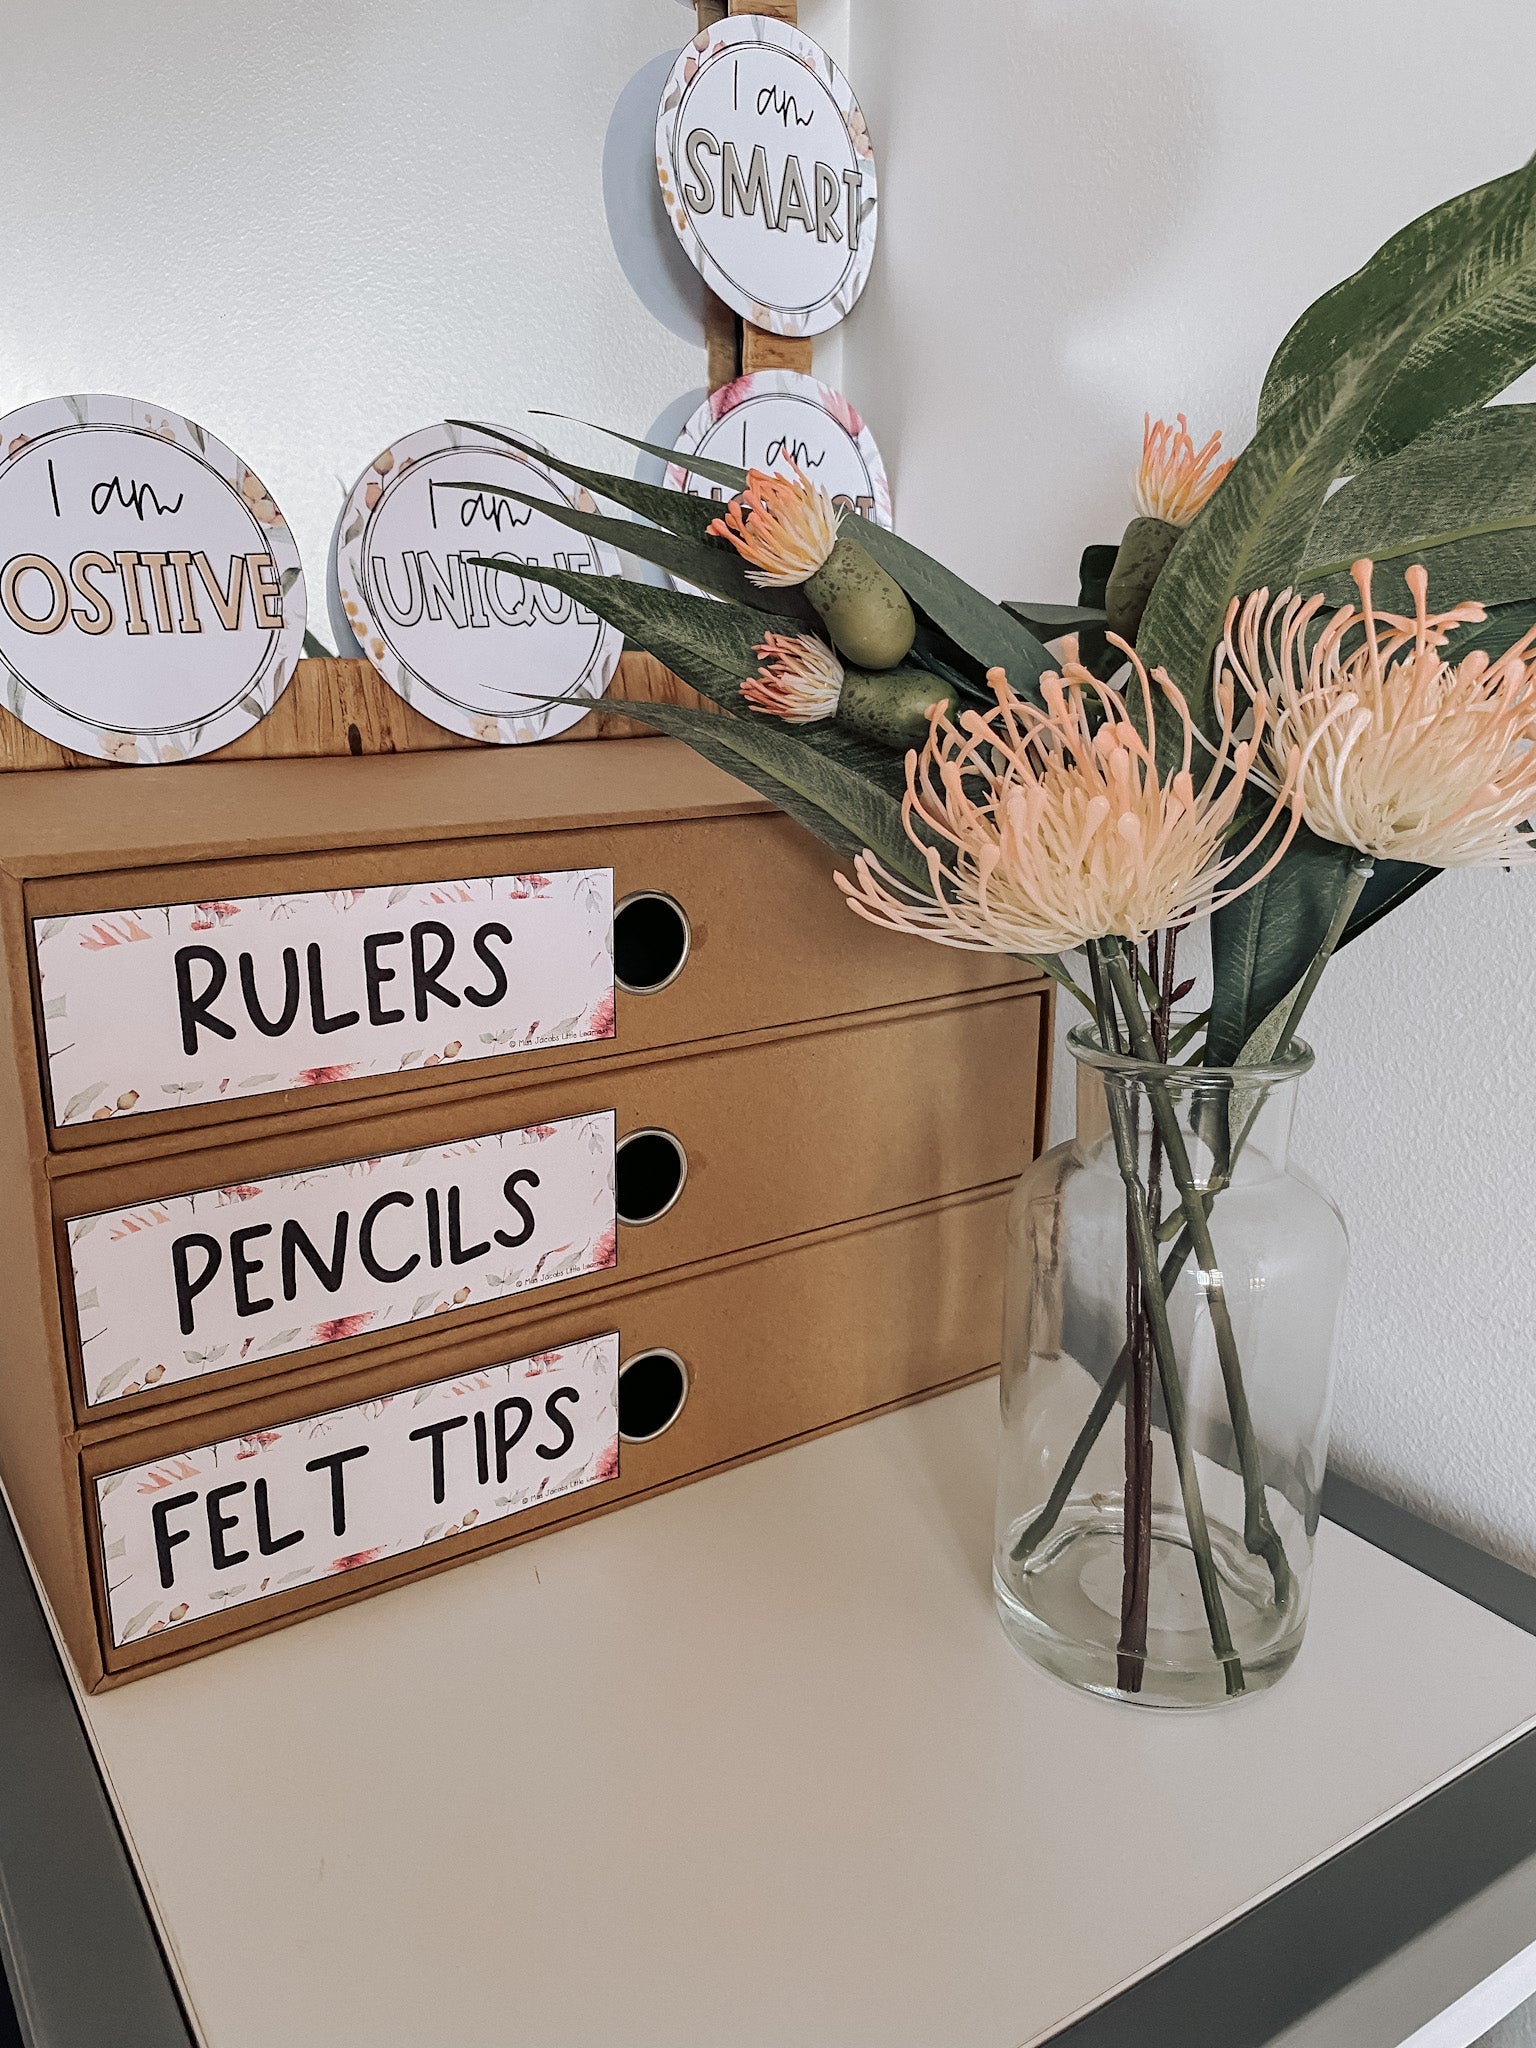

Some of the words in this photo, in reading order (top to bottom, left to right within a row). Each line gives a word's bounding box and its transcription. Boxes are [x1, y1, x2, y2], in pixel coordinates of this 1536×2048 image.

[733, 59, 739, 111] I
[756, 84, 815, 128] am
[684, 127, 863, 251] SMART
[765, 435, 826, 469] am
[48, 459, 61, 518] I
[91, 475, 184, 521] am
[428, 478, 438, 530] I
[460, 492, 533, 533] am
[173, 920, 513, 1056] RULERS
[534, 1034, 560, 1044] Jacobs
[171, 1168, 541, 1336] PENCILS
[540, 1270, 563, 1281] Jacobs
[151, 1445, 370, 1590] FELT
[408, 1386, 581, 1505] TIPS
[545, 1486, 568, 1497] Jacobs
